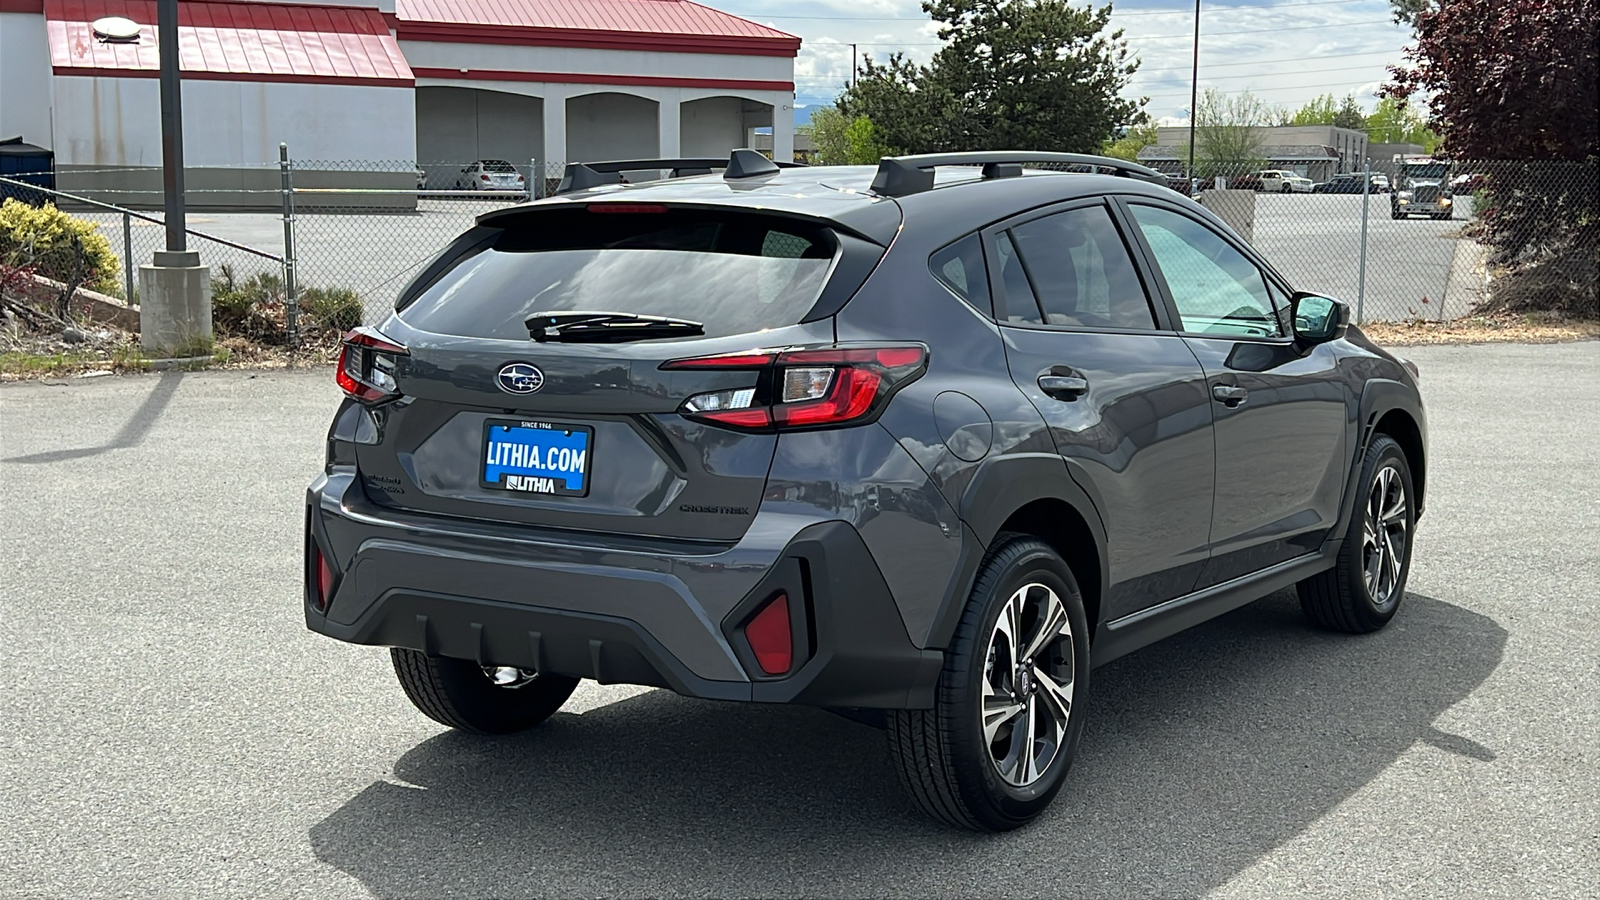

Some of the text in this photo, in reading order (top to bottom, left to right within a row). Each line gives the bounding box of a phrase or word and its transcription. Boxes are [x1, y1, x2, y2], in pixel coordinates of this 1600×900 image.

[486, 441, 586, 473] LITHIA.COM
[517, 476, 555, 493] LITHIA
[679, 504, 749, 515] CROSSTREK
